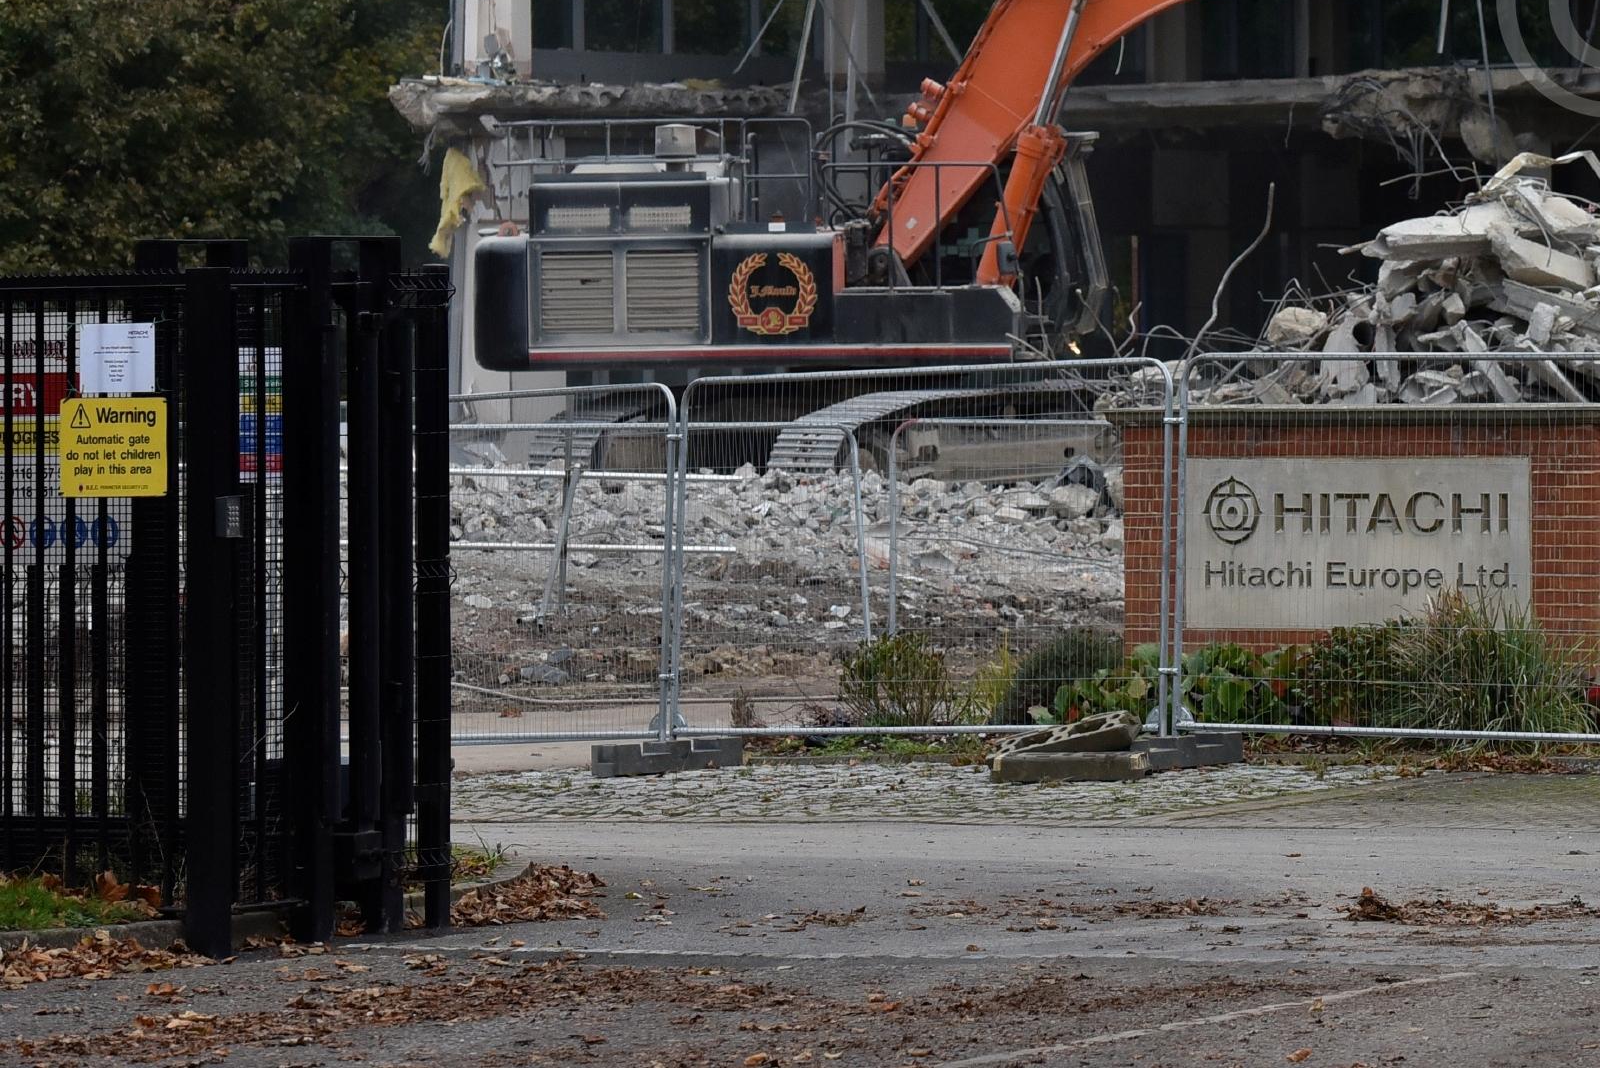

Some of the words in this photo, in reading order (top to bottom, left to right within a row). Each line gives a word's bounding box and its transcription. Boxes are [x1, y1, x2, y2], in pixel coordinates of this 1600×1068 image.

[96, 407, 156, 427] Warning
[76, 434, 124, 445] Automatic
[128, 434, 150, 447] gate
[66, 450, 79, 461] do
[83, 450, 99, 460] not
[103, 449, 116, 460] let
[120, 449, 161, 460] children
[74, 464, 93, 477] play
[97, 464, 105, 474] in
[109, 464, 126, 474] this
[130, 465, 152, 474] area
[1273, 492, 1511, 534] HITACHI
[1204, 560, 1313, 589] Hitachi
[1325, 561, 1443, 597] Europe
[1456, 561, 1519, 590] Ltd.
